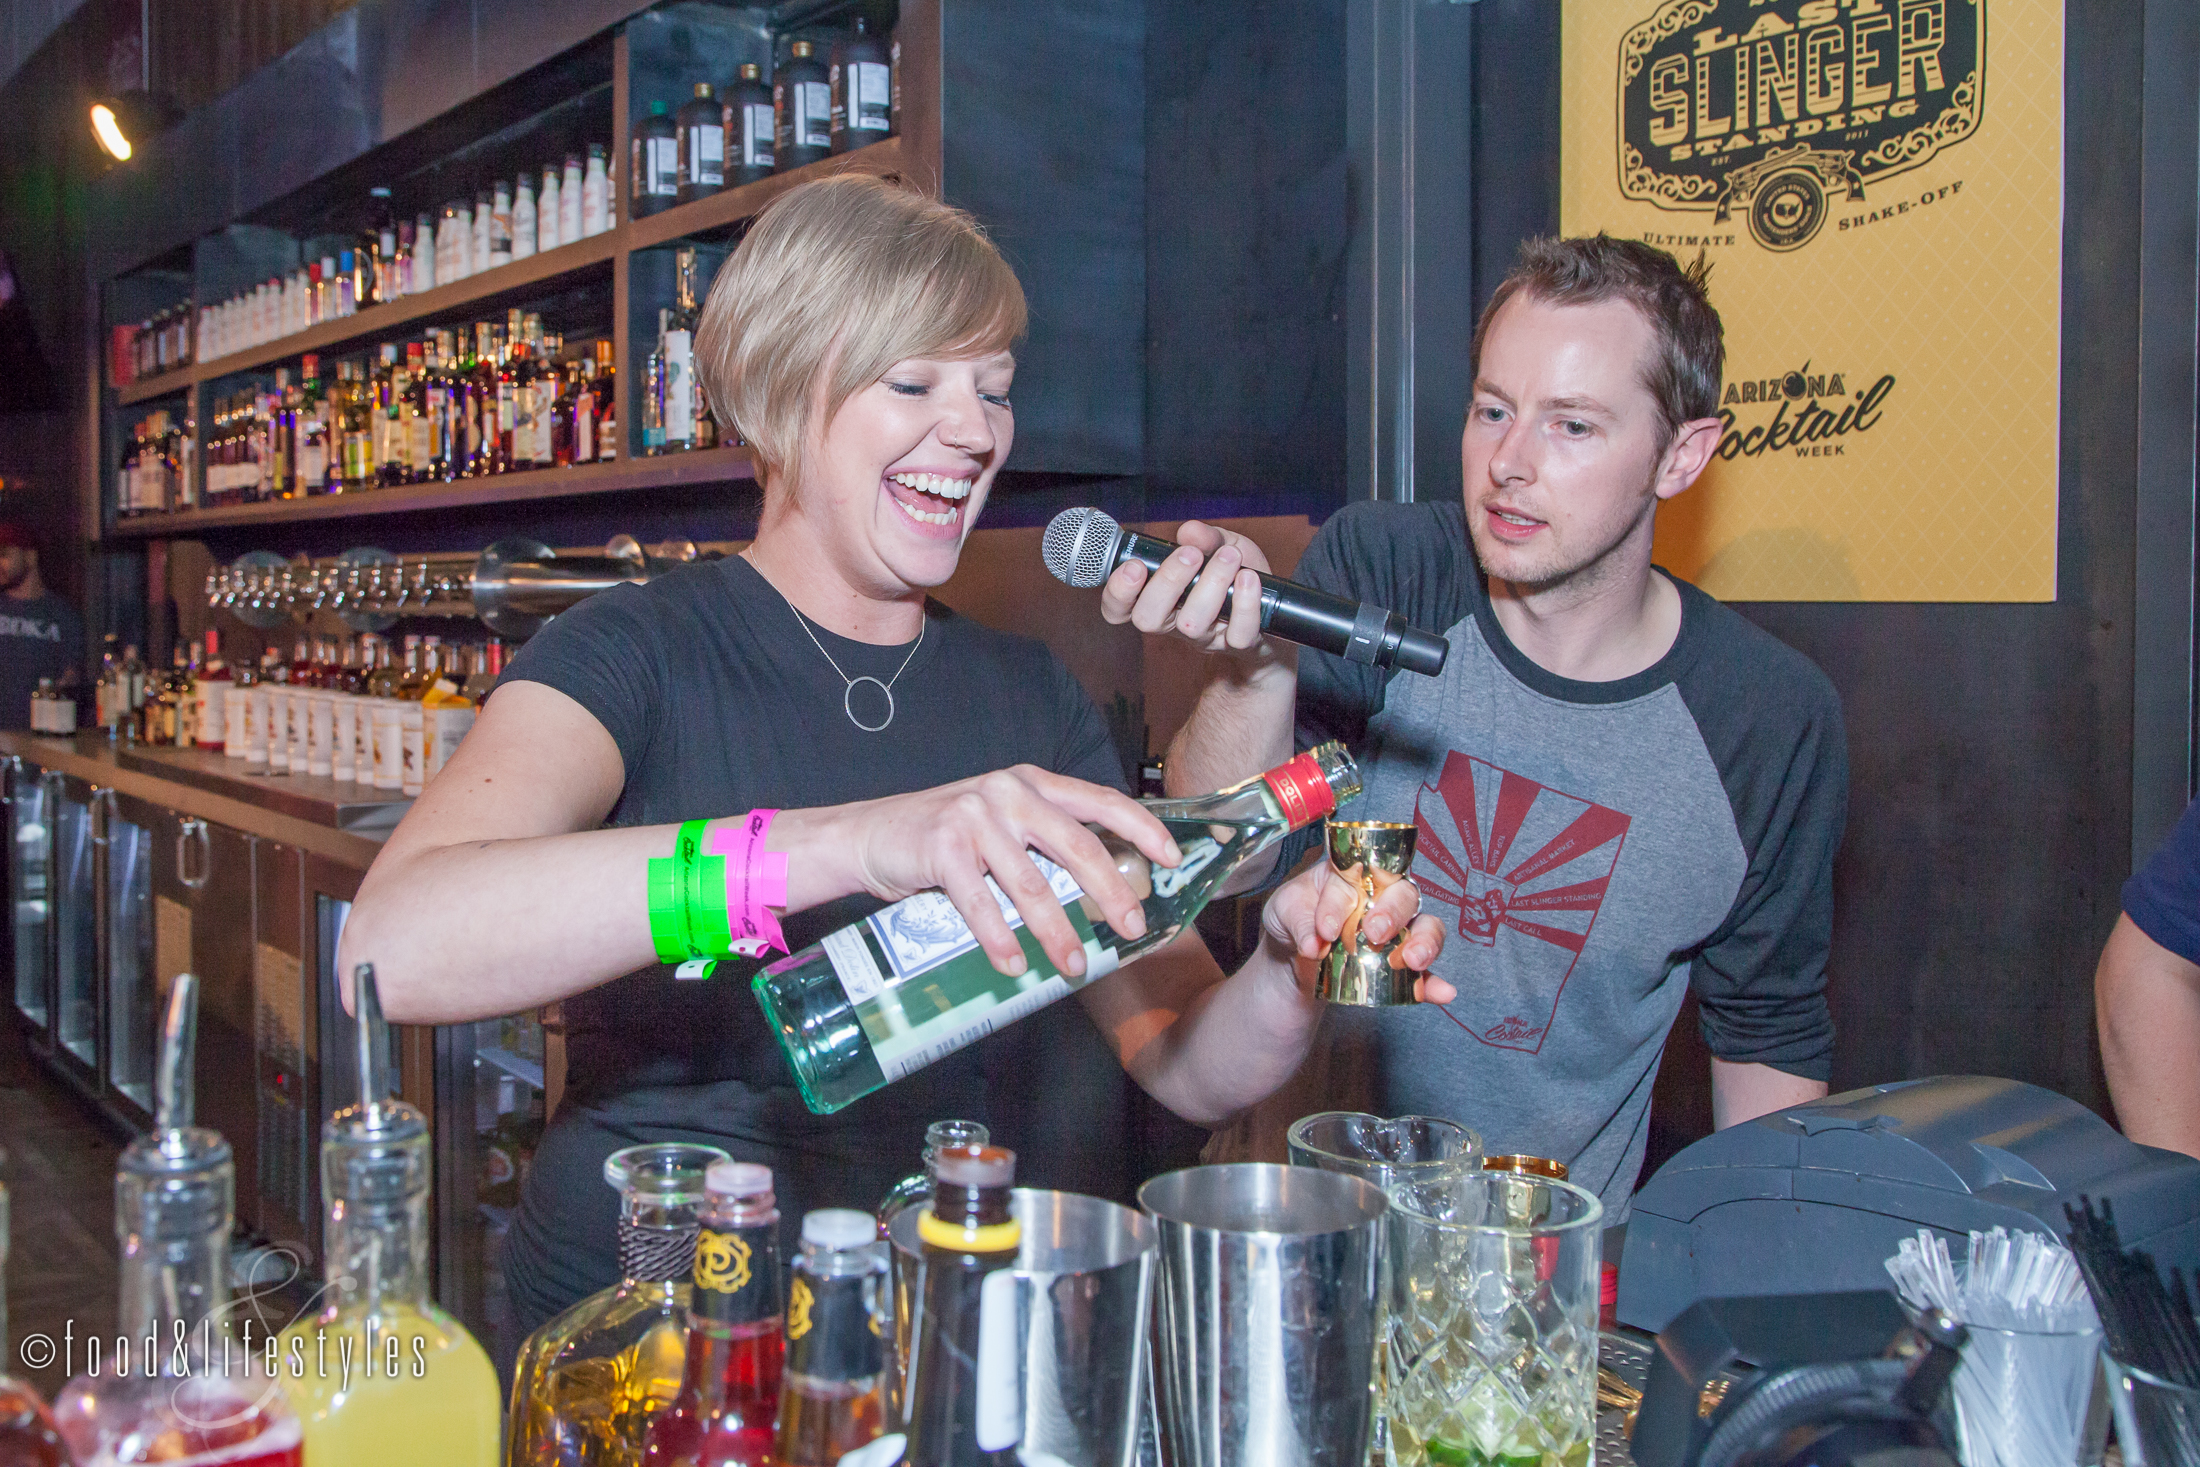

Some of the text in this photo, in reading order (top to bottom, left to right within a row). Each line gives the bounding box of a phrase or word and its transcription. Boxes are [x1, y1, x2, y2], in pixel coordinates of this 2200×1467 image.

[1693, 0, 1883, 56] LAST
[1649, 0, 1945, 147] SLINGER
[1670, 99, 1919, 162] STANDING
[1642, 180, 1964, 247] ULTIMATE SHAKE-OFF
[1723, 368, 1846, 405] ARIZONA
[1795, 445, 1845, 457] WEEK
[1123, 533, 1139, 559] SHURE
[1279, 778, 1304, 817] DOLIN
[1416, 832, 1442, 859] OCKTAIL
[1513, 838, 1576, 882] ARTISANAL MARKET
[1511, 892, 1602, 908] LAST SLINGER STANDING
[1504, 916, 1541, 936] LAST CALL
